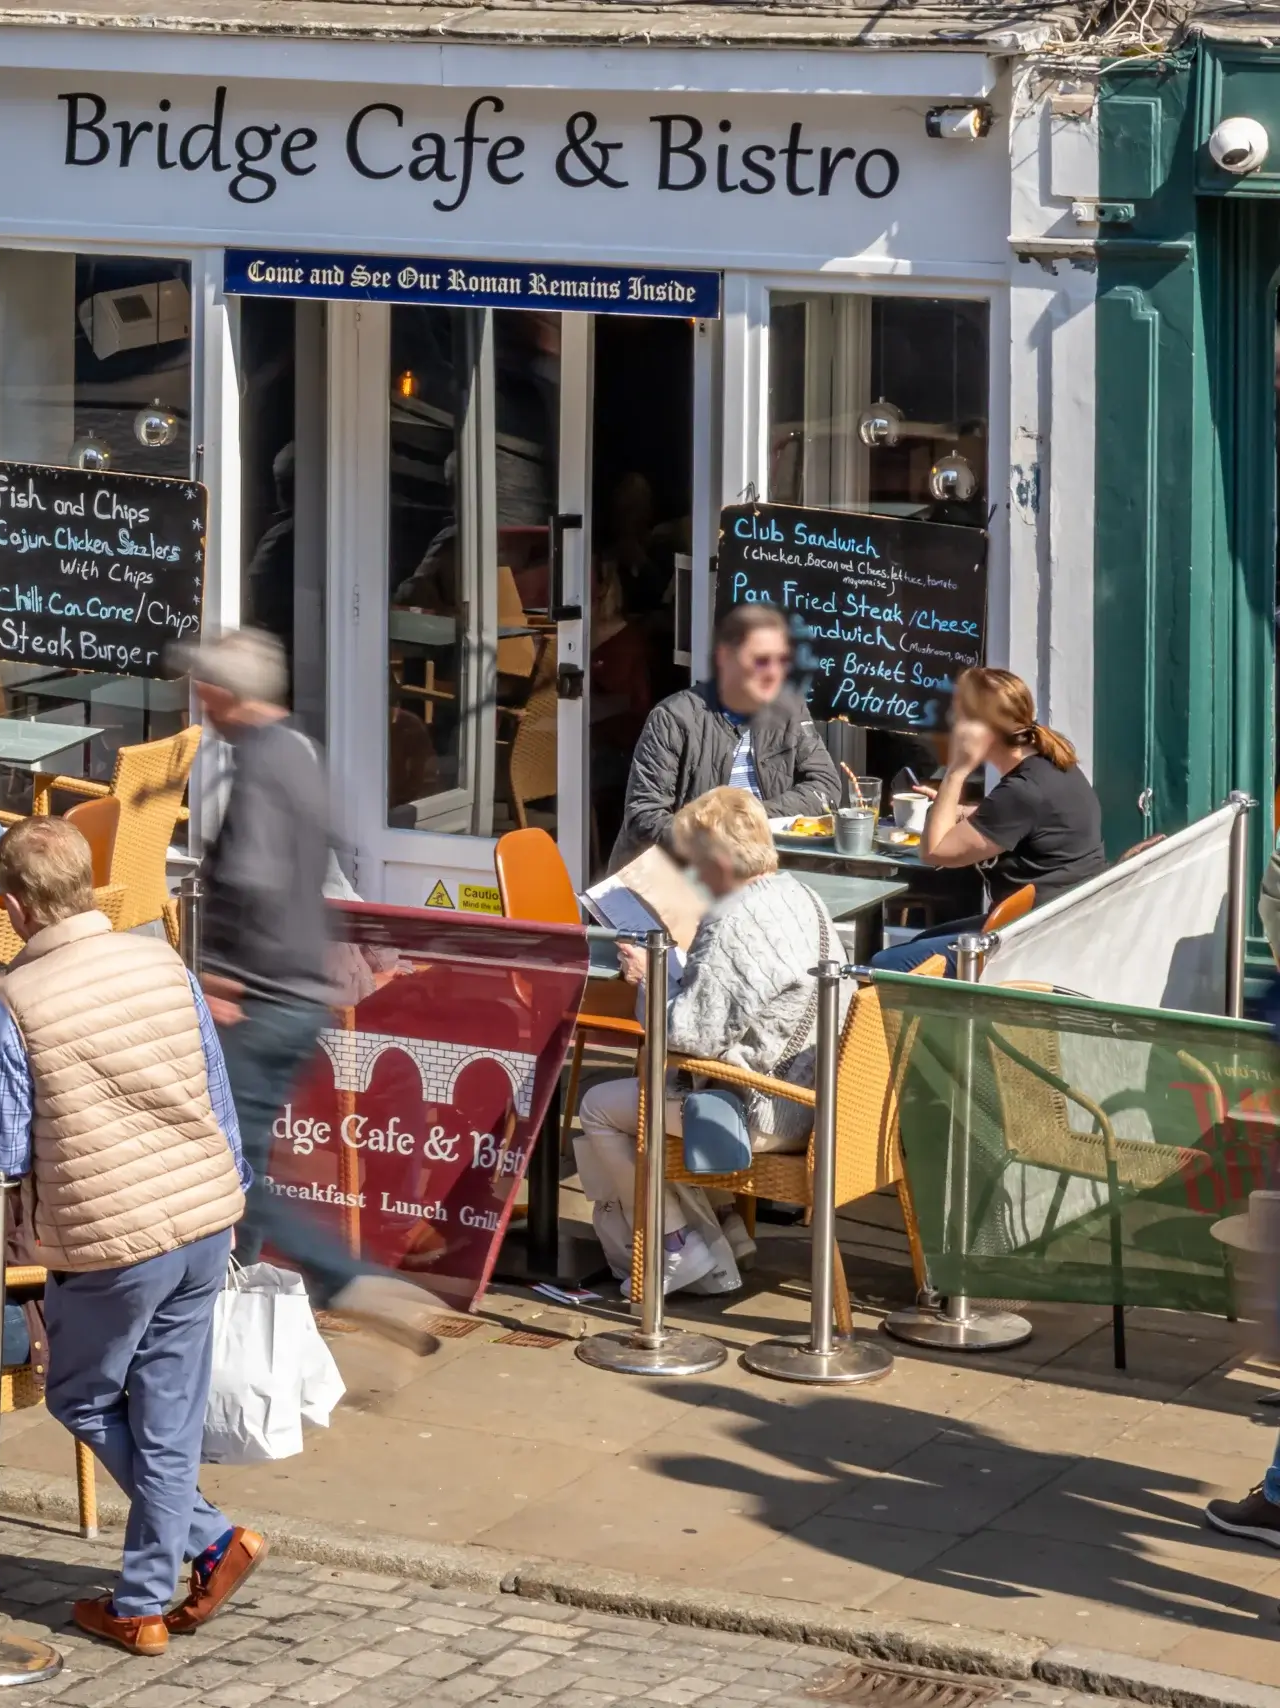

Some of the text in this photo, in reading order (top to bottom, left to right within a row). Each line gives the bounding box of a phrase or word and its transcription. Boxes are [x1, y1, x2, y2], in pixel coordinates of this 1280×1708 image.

[58, 86, 900, 212] Bridge Cafe & Bistro
[248, 260, 696, 303] Come and See Our Roman Remains Inside
[54, 493, 84, 516] and
[93, 490, 150, 528] Chips
[54, 528, 114, 556] Chicken
[117, 528, 181, 562] Sizzlers
[734, 515, 880, 559] Club Sandwich
[60, 558, 154, 589] With Chips
[927, 574, 958, 590] tomato
[733, 572, 771, 603] Pan
[783, 580, 837, 614] Fried
[842, 593, 903, 625] Steak
[79, 630, 159, 668] Burger
[790, 614, 896, 651] ndwich
[843, 652, 905, 684] Brisket
[462, 900, 479, 909] Mind
[464, 887, 501, 901] Cautio
[271, 1103, 527, 1178] dge Cafe & Bist
[262, 1175, 367, 1208] Breakfast
[380, 1191, 448, 1222] Lunch
